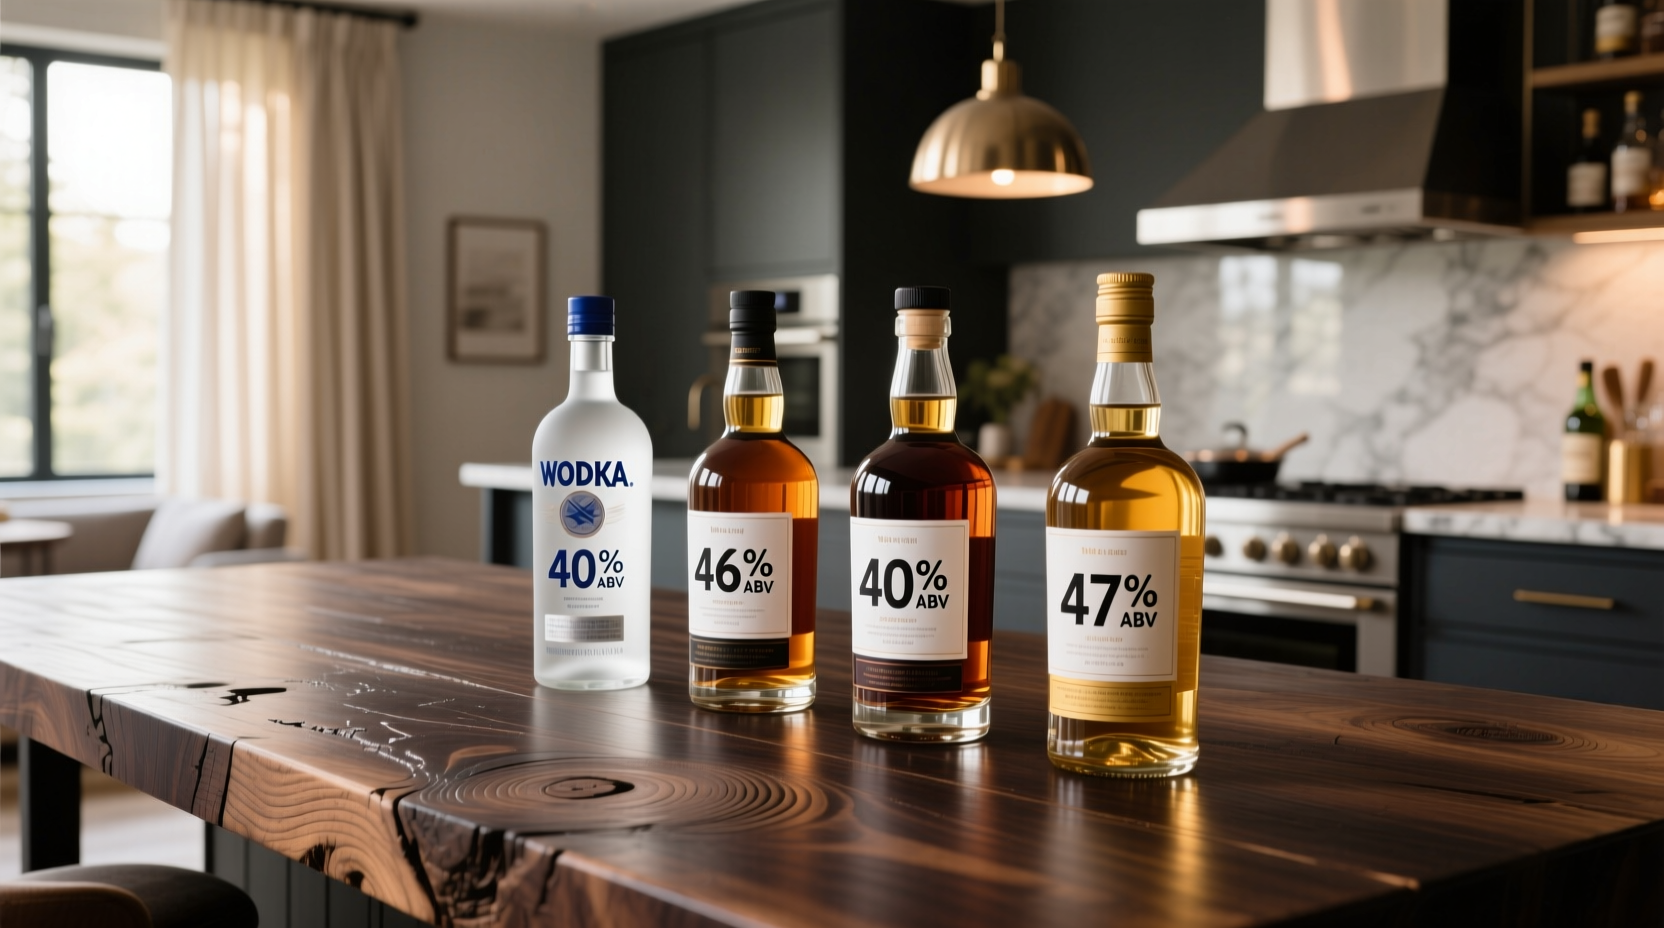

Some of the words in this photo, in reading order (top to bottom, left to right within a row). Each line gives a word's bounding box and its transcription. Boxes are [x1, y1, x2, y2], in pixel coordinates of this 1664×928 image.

[548, 548, 624, 589] 40%
[597, 576, 625, 588] ABV
[694, 547, 774, 593] 46%
[743, 580, 775, 594] ABV
[859, 557, 948, 609] 40%
[915, 593, 950, 609] ABV
[1060, 572, 1158, 627] 47%
[1120, 611, 1158, 628] ABV
